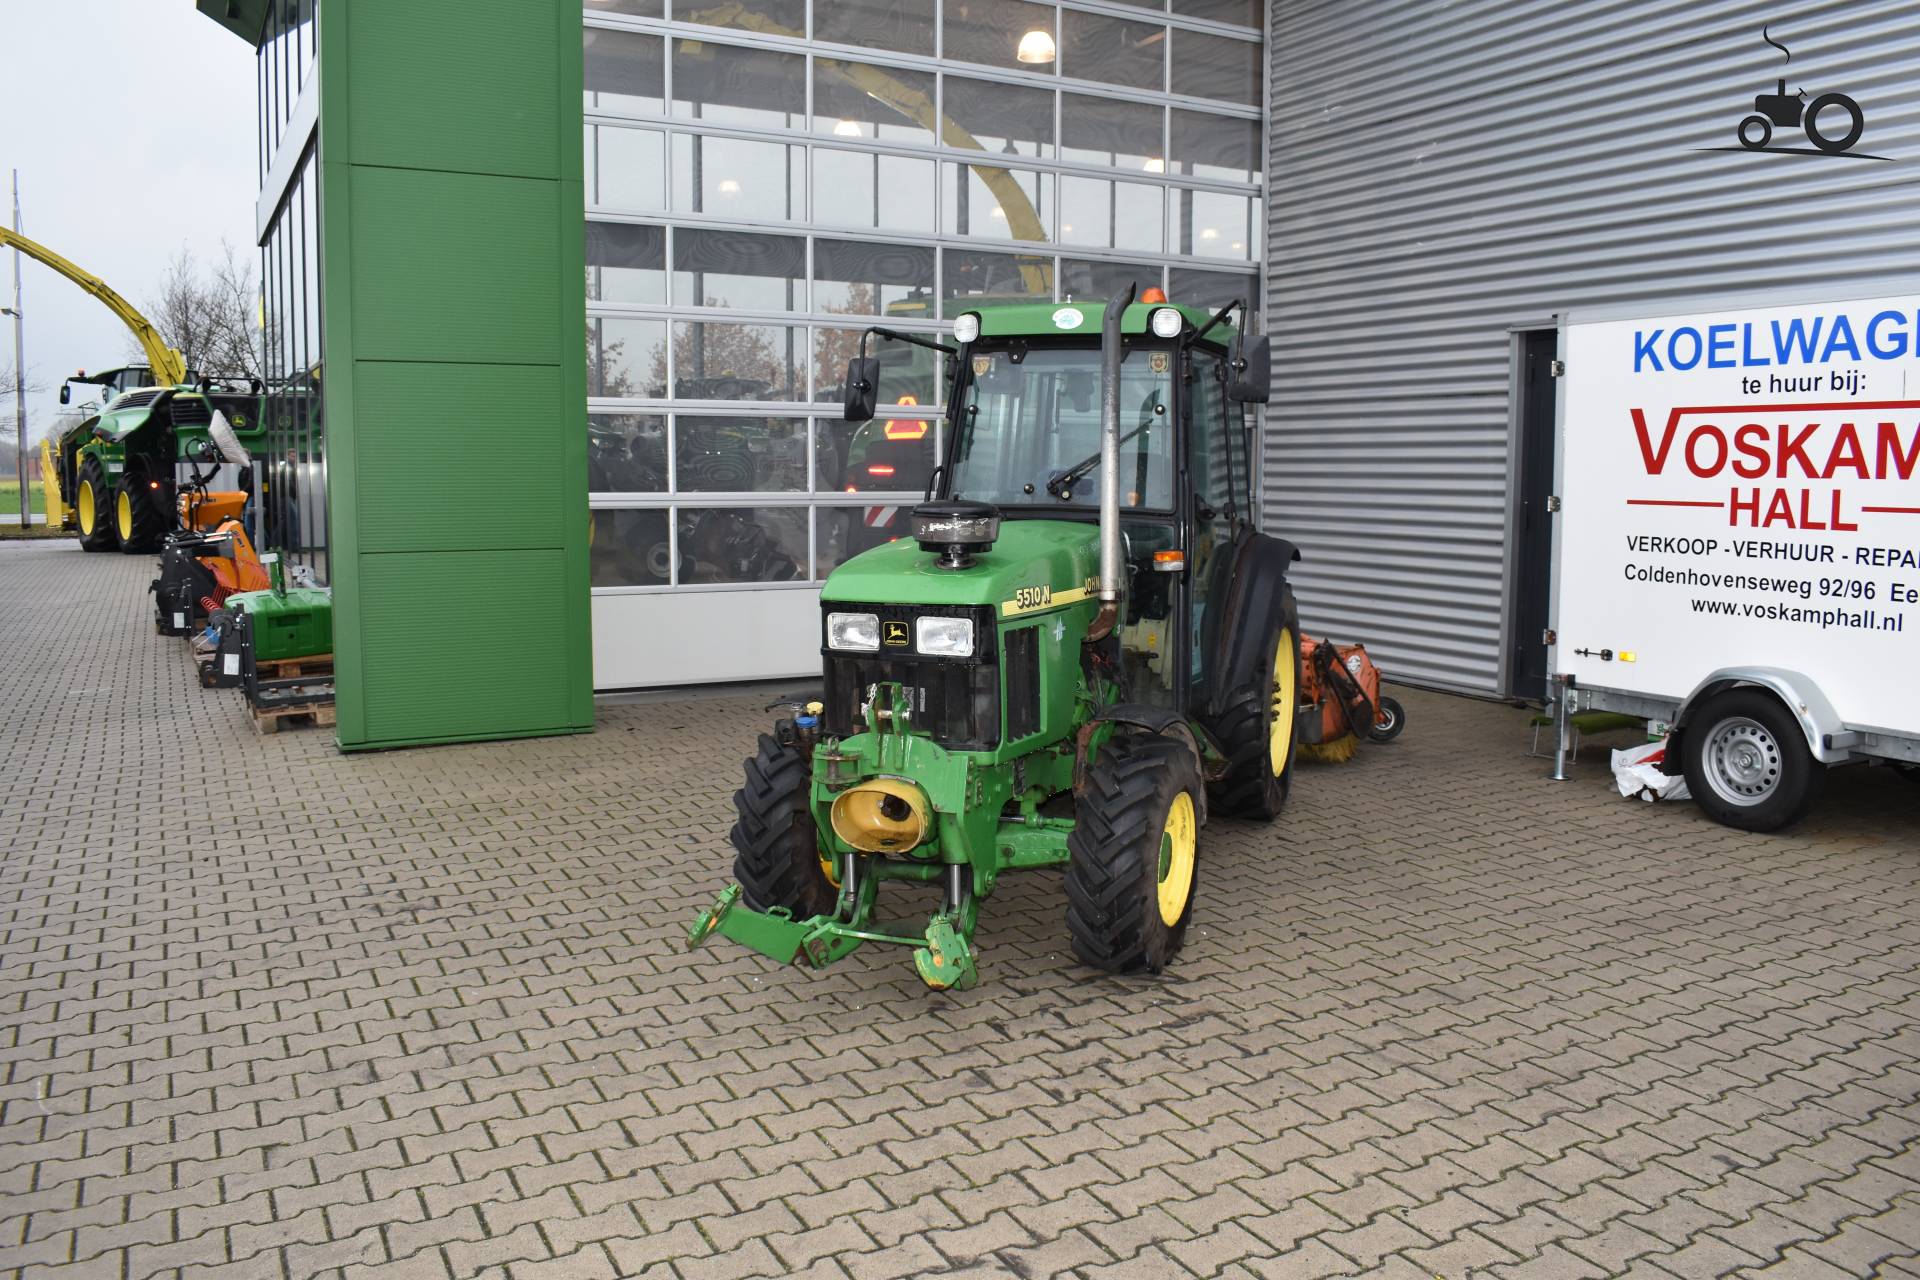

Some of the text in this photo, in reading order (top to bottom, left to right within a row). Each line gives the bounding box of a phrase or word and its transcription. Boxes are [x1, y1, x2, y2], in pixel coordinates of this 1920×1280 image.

[1634, 308, 1920, 373] KOELWAG
[1742, 370, 1866, 396] te huur bij:
[1629, 408, 1920, 480] VOSKAM
[1729, 487, 1858, 532] HALL
[1626, 535, 1718, 556] VERKOOP
[1016, 586, 1041, 609] 5510
[1624, 563, 1812, 600] Coldenhovenseweg
[1819, 576, 1876, 600] 92/96
[1691, 599, 1903, 632] www.voskamphall.nl
